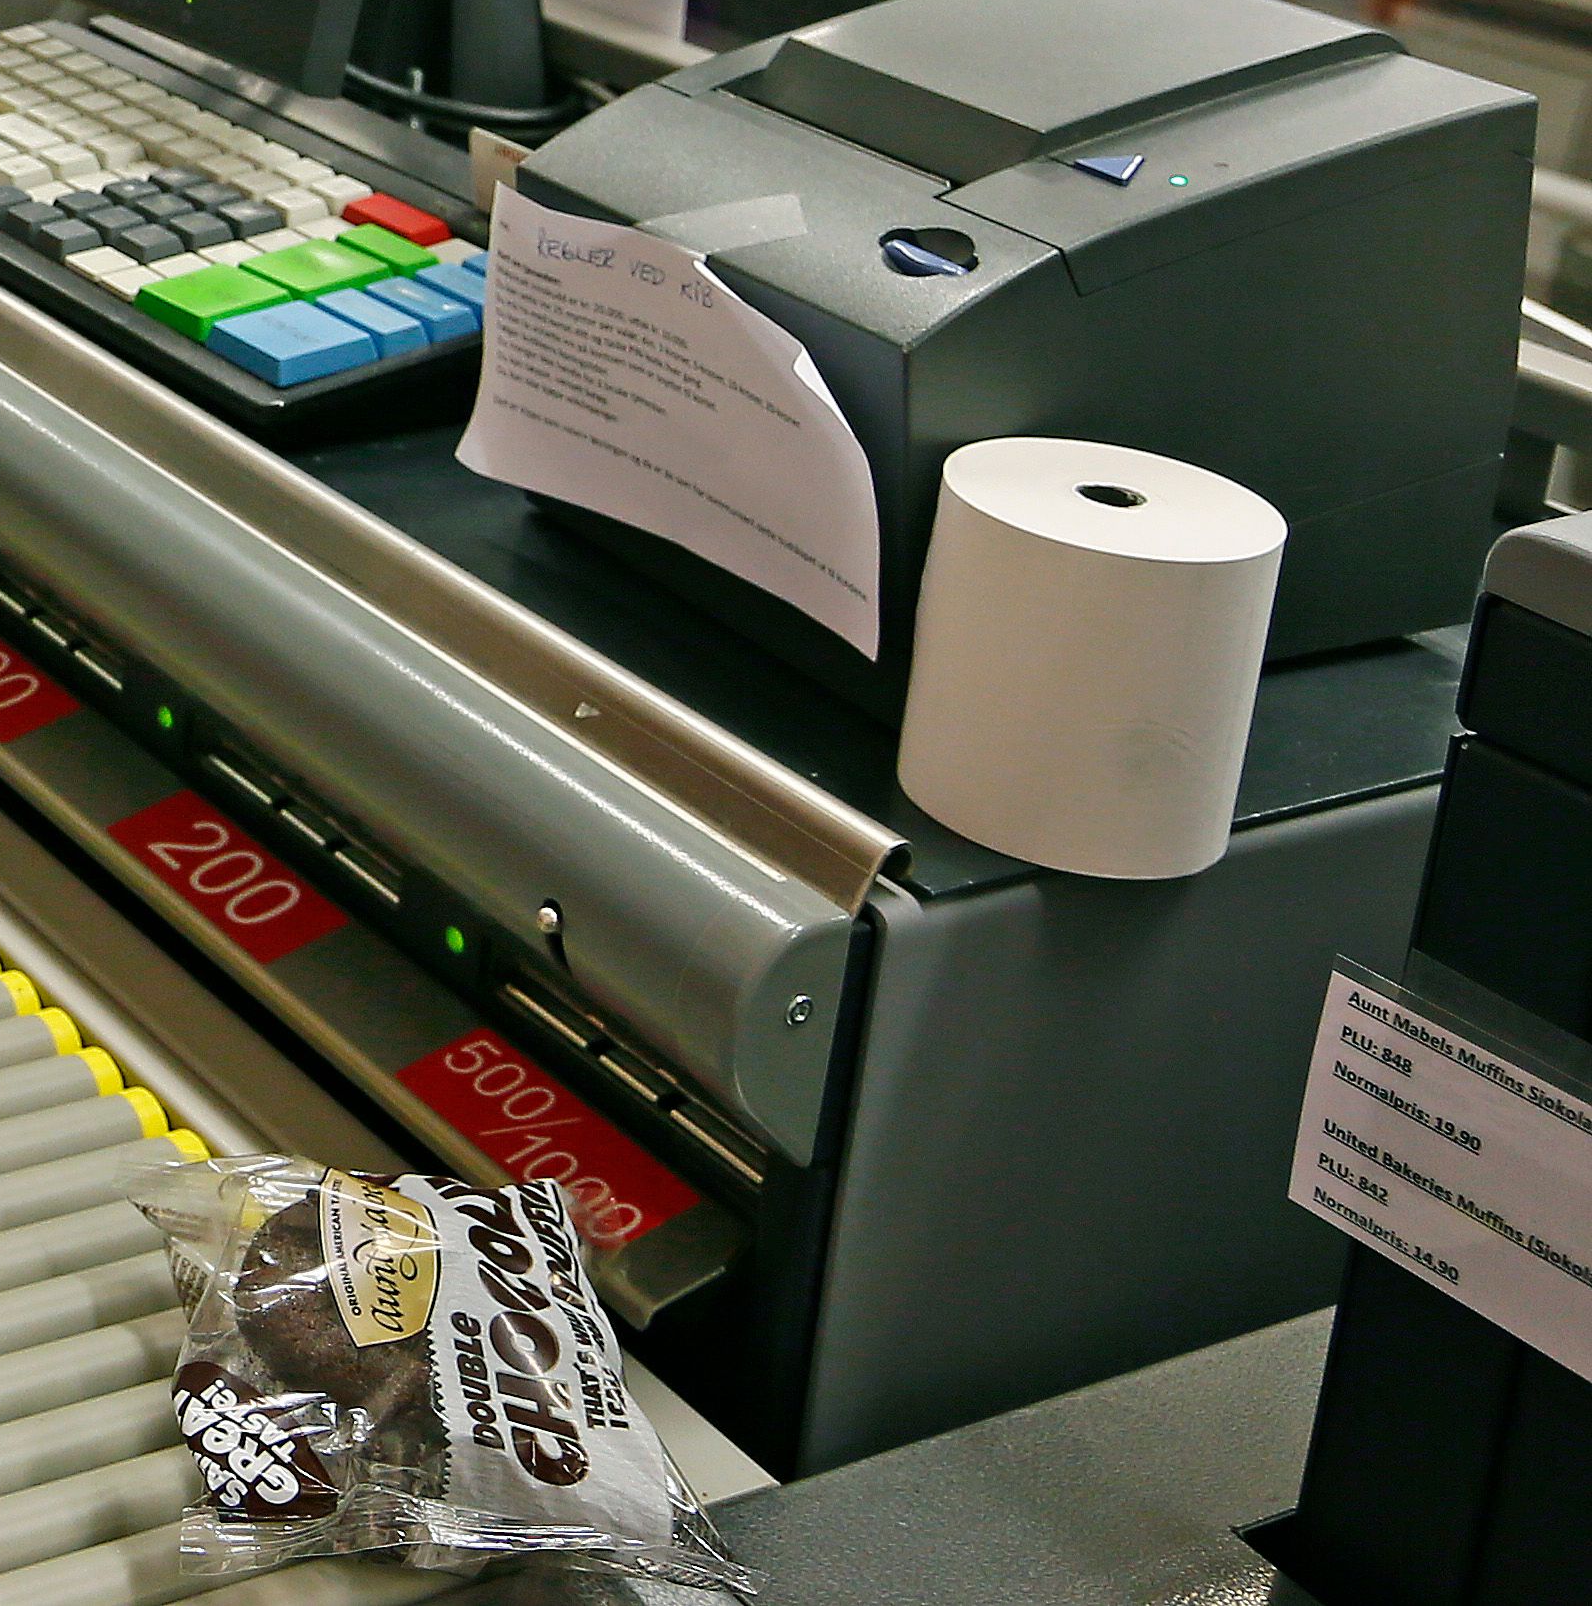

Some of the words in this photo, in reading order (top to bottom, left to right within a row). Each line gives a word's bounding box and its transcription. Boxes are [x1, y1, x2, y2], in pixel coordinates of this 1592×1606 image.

[536, 228, 615, 269] REGLER
[630, 259, 666, 286] VED
[147, 820, 301, 925] 200
[1341, 1025, 1379, 1055] PLU:
[1381, 1047, 1413, 1074] 848
[1348, 991, 1390, 1021] Aunt
[1393, 1013, 1453, 1056] Mabels
[1458, 1047, 1526, 1094] Muffins
[1334, 1060, 1430, 1125] Normalpris:
[1318, 1152, 1354, 1182] PLU:
[1358, 1175, 1389, 1202] 842
[1323, 1118, 1378, 1159] United
[1382, 1151, 1453, 1202] Bakeries
[1457, 1194, 1524, 1243] Muffins
[1313, 1185, 1408, 1251] Normalpris:
